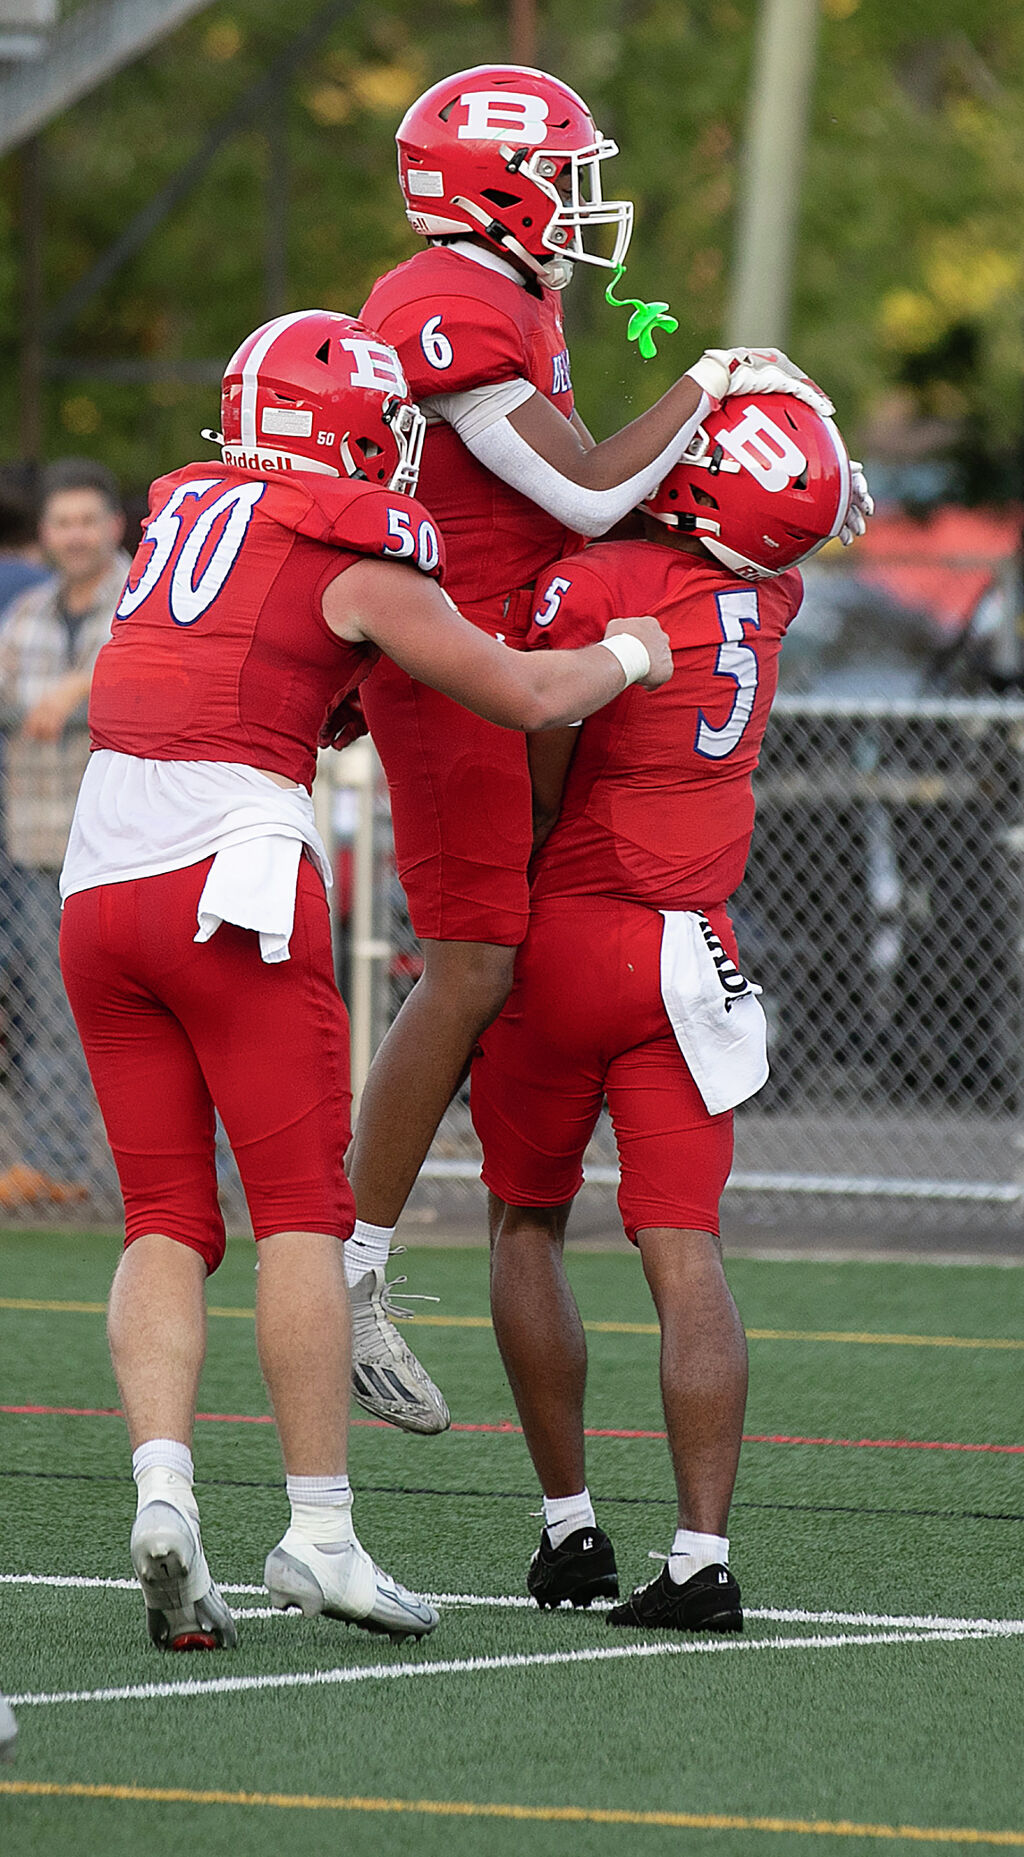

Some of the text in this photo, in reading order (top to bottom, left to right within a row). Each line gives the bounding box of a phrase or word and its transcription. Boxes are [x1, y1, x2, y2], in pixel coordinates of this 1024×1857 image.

[458, 91, 549, 145] B
[340, 338, 408, 398] B
[420, 314, 454, 371] 6
[224, 450, 293, 472] Riddell
[316, 430, 336, 446] 50
[714, 404, 808, 493] B
[116, 478, 268, 626] 50
[383, 507, 440, 571] 50
[534, 576, 573, 627] 5
[693, 588, 761, 761] 5
